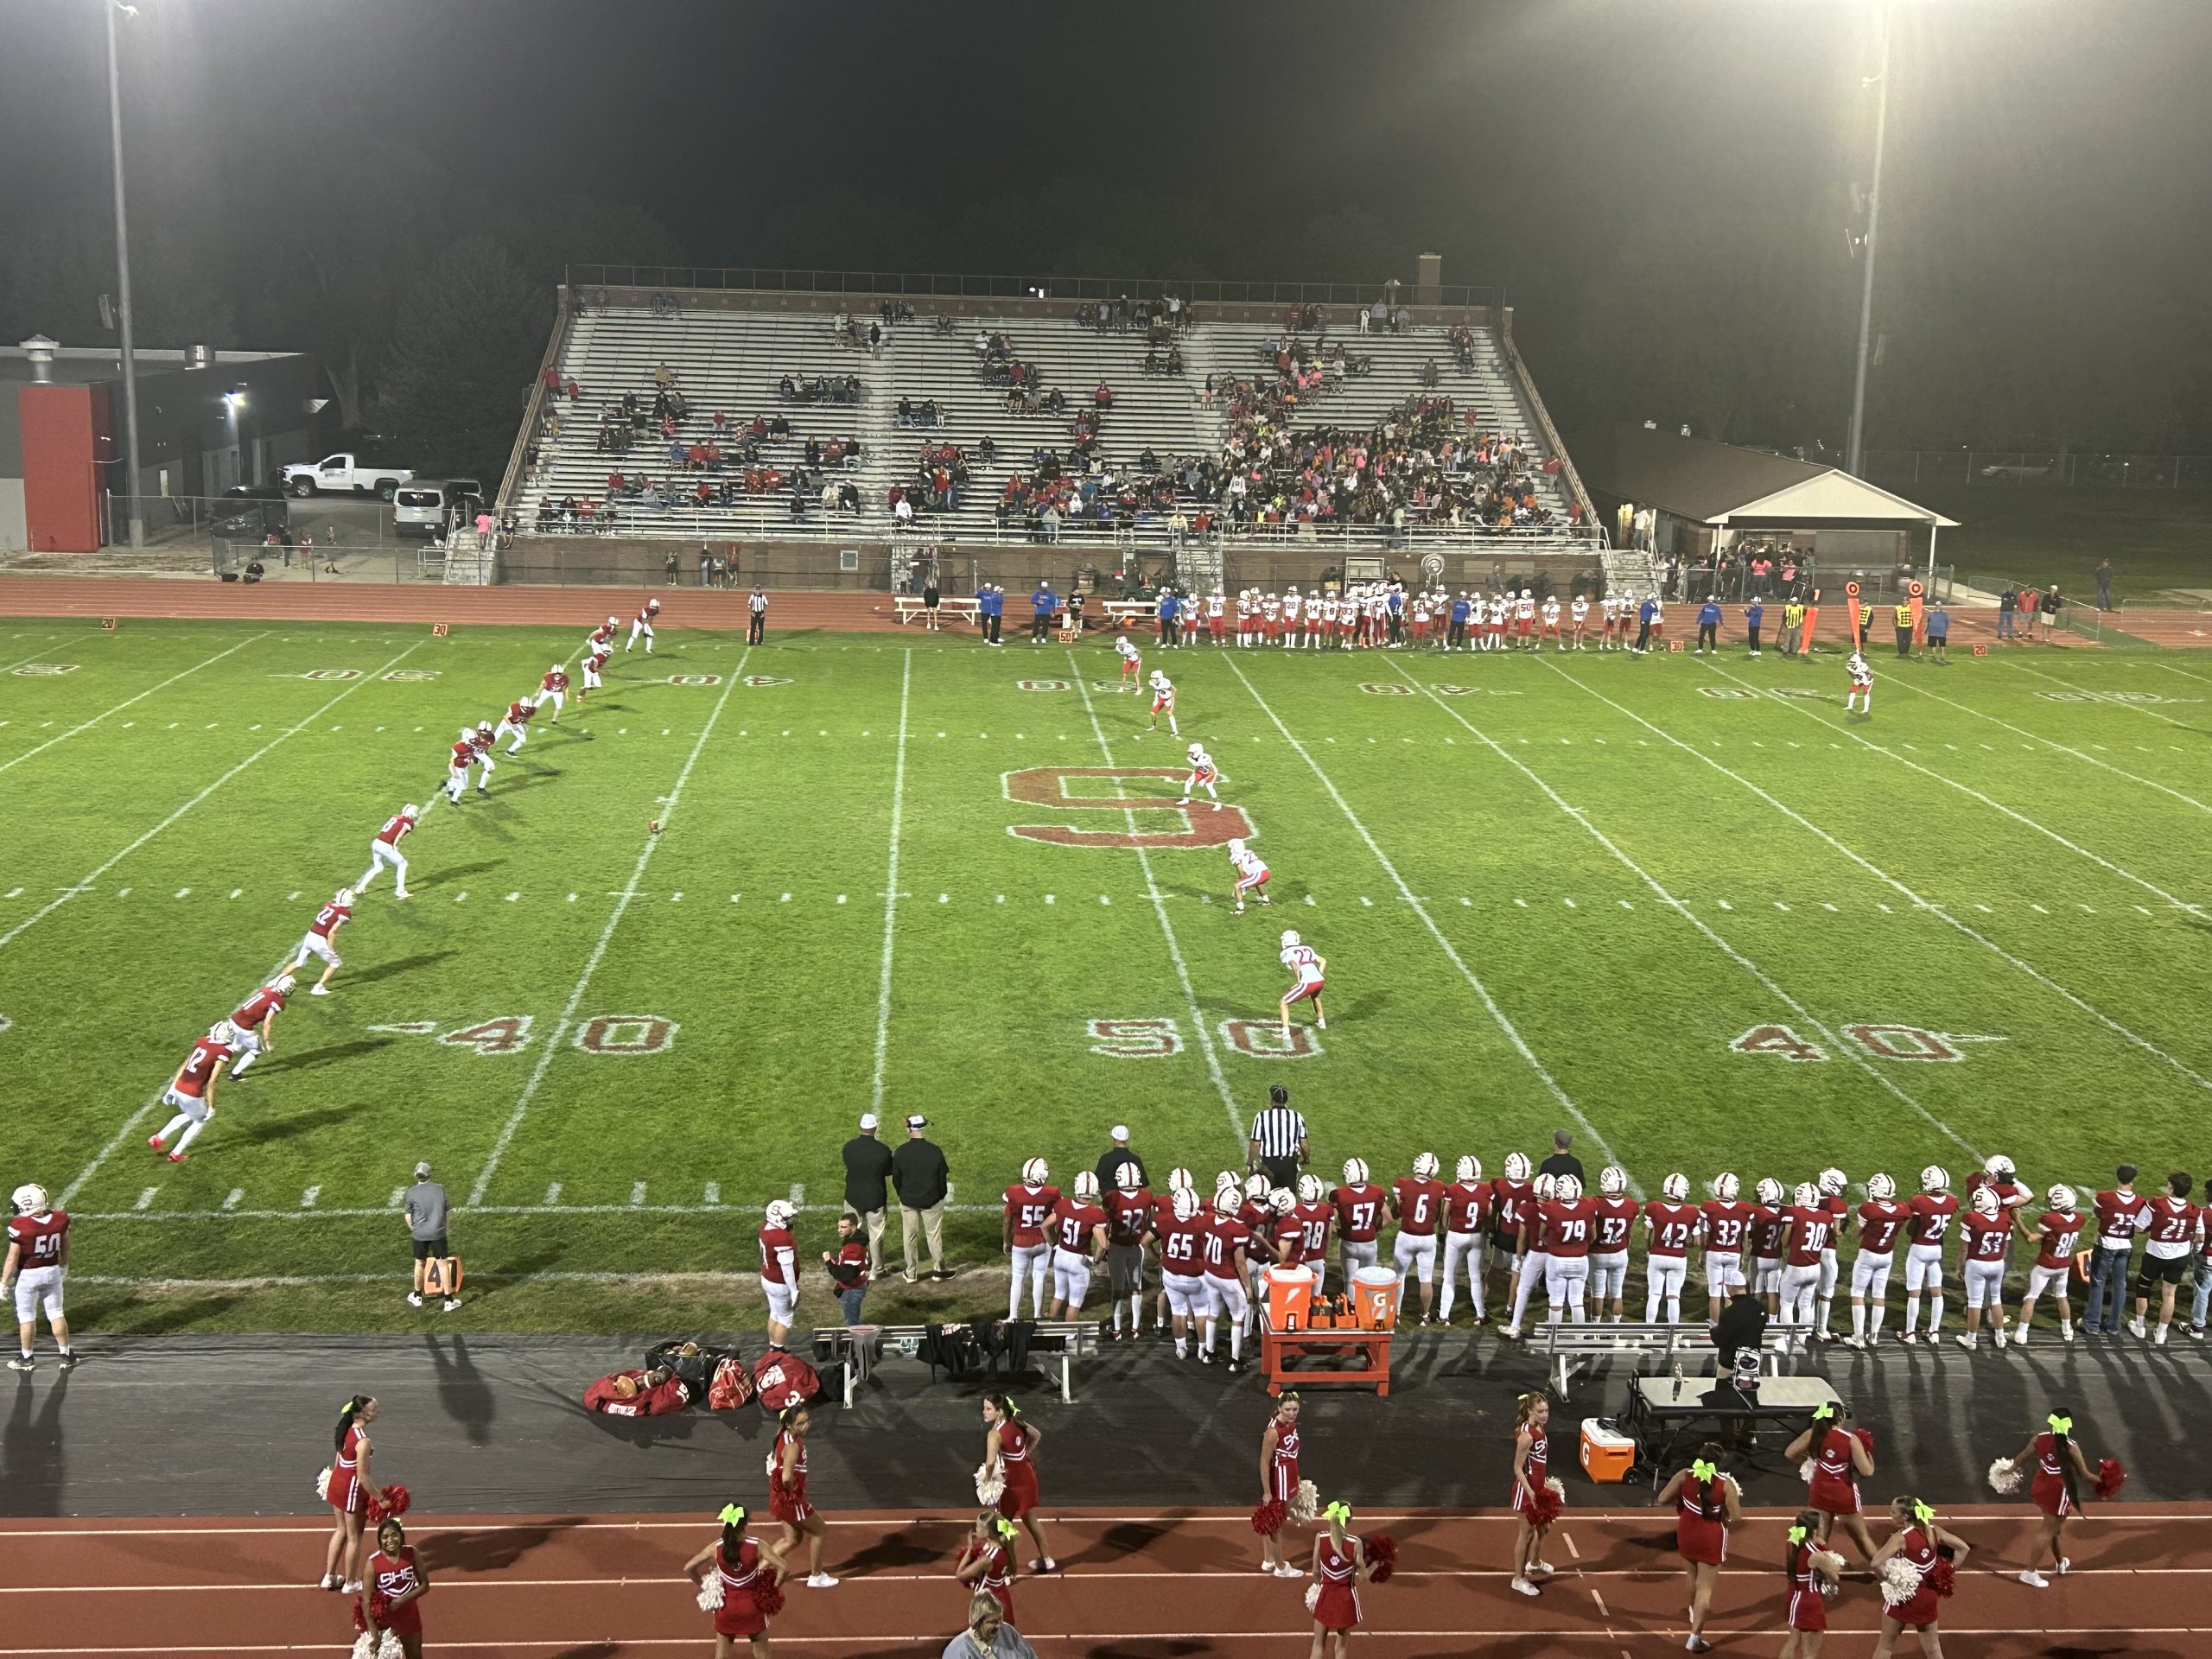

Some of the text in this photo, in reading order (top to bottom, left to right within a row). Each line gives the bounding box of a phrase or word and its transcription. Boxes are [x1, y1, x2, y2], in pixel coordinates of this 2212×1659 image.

[1212, 602, 1224, 612] 67
[102, 618, 114, 629] 20
[435, 624, 446, 635] 30
[1060, 632, 1071, 642] 50
[1975, 645, 1986, 655] 20
[1000, 766, 1260, 849] S
[243, 993, 266, 1011] 11
[435, 1014, 682, 1056] 40
[1086, 1016, 1325, 1059] 50
[1728, 1023, 1965, 1063] 40
[1020, 1205, 1046, 1228] 55
[1351, 1202, 1376, 1230] 57
[1414, 1193, 1429, 1224] 6
[1465, 1201, 1479, 1229] 9
[1062, 1217, 1082, 1247] 51
[1118, 1208, 1144, 1236] 32
[1560, 1219, 1586, 1243] 79
[1599, 1217, 1627, 1244] 52
[1715, 1219, 1742, 1246] 33
[1878, 1221, 1896, 1247] 7
[1924, 1214, 1951, 1240] 25
[2160, 1217, 2187, 1240] 21
[35, 1233, 60, 1259] 50
[1166, 1232, 1194, 1261] 65
[1205, 1231, 1223, 1266] 70
[1661, 1222, 1688, 1249] 42
[1800, 1220, 1828, 1252] 30
[1373, 1292, 1387, 1307] G
[1581, 1440, 1591, 1466] G
[379, 1565, 415, 1587] SHS
